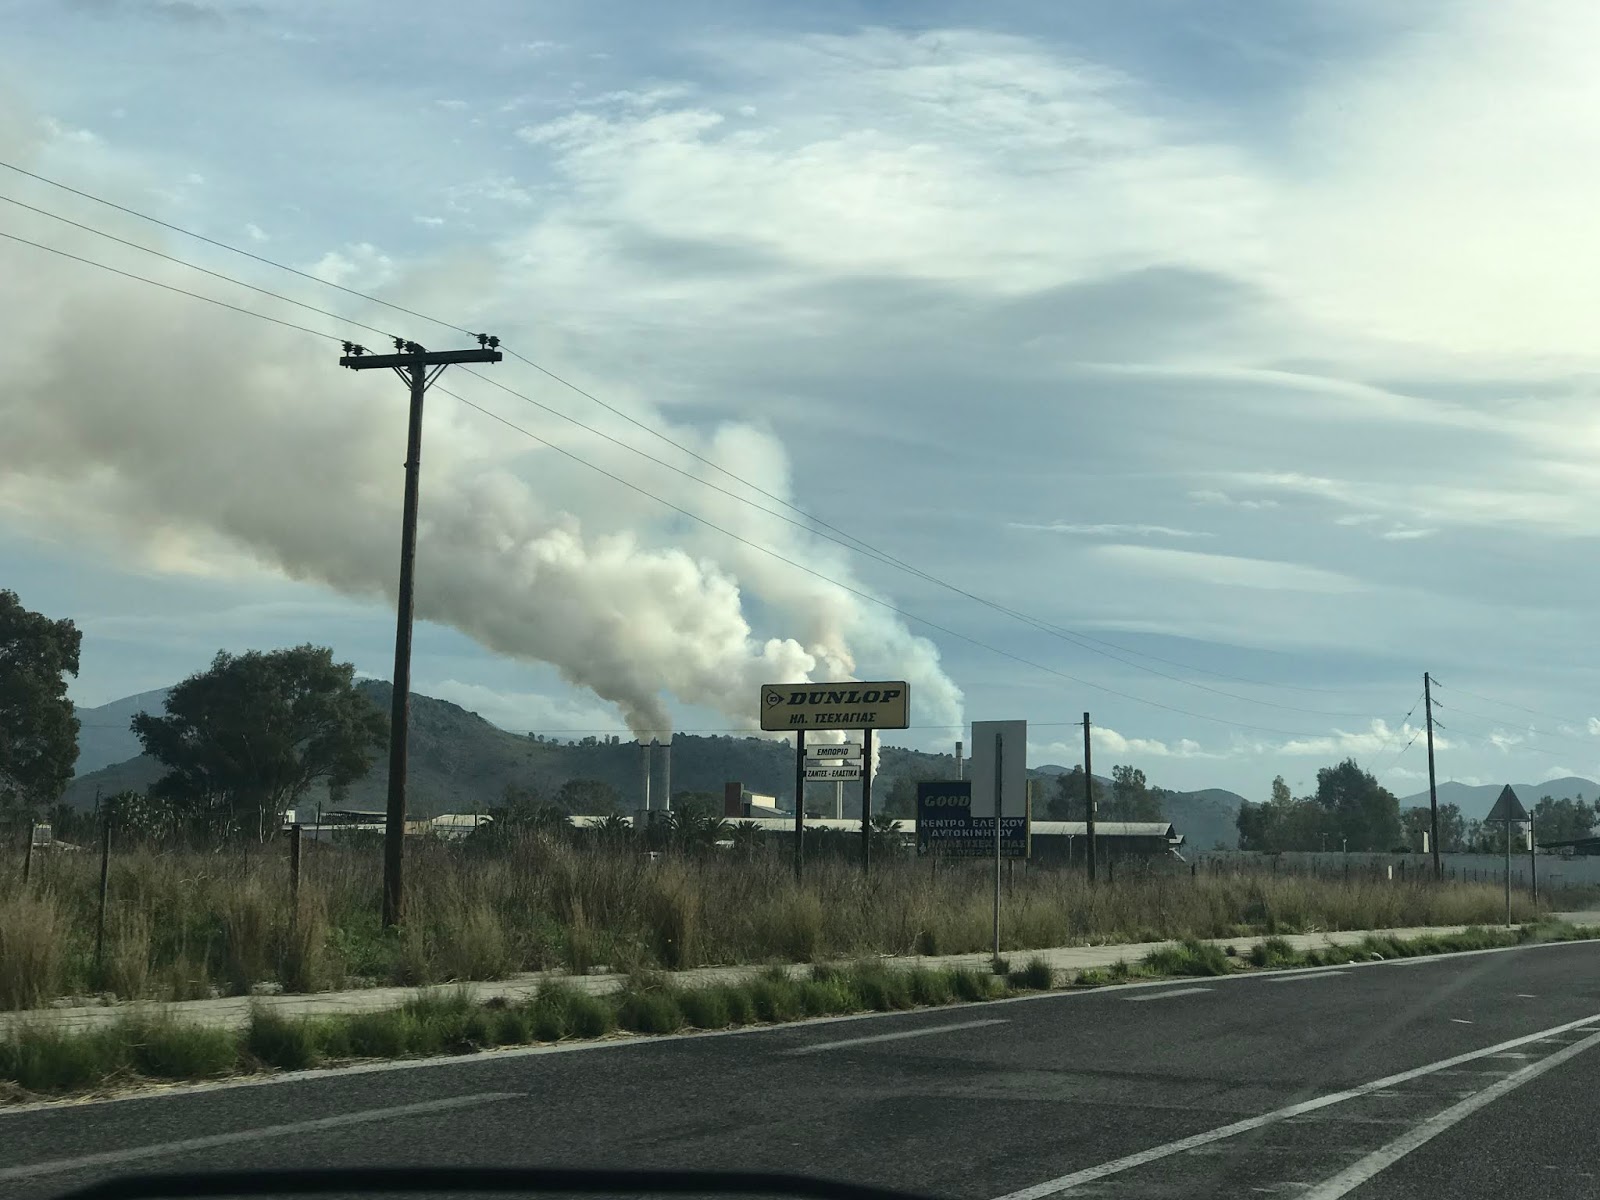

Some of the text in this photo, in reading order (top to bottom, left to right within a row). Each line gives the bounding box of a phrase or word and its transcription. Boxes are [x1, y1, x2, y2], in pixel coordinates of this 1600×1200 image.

[787, 690, 901, 705] DUNLOP
[815, 712, 877, 723] ΤΣΕΧΑΓΙΑΣ
[817, 748, 849, 756] ΕΜΠΟΡΙΟ
[924, 795, 971, 807] GOOD
[921, 819, 1025, 827] ΚΕΝΤΡΟ ΕΛΕΧΟΥ
